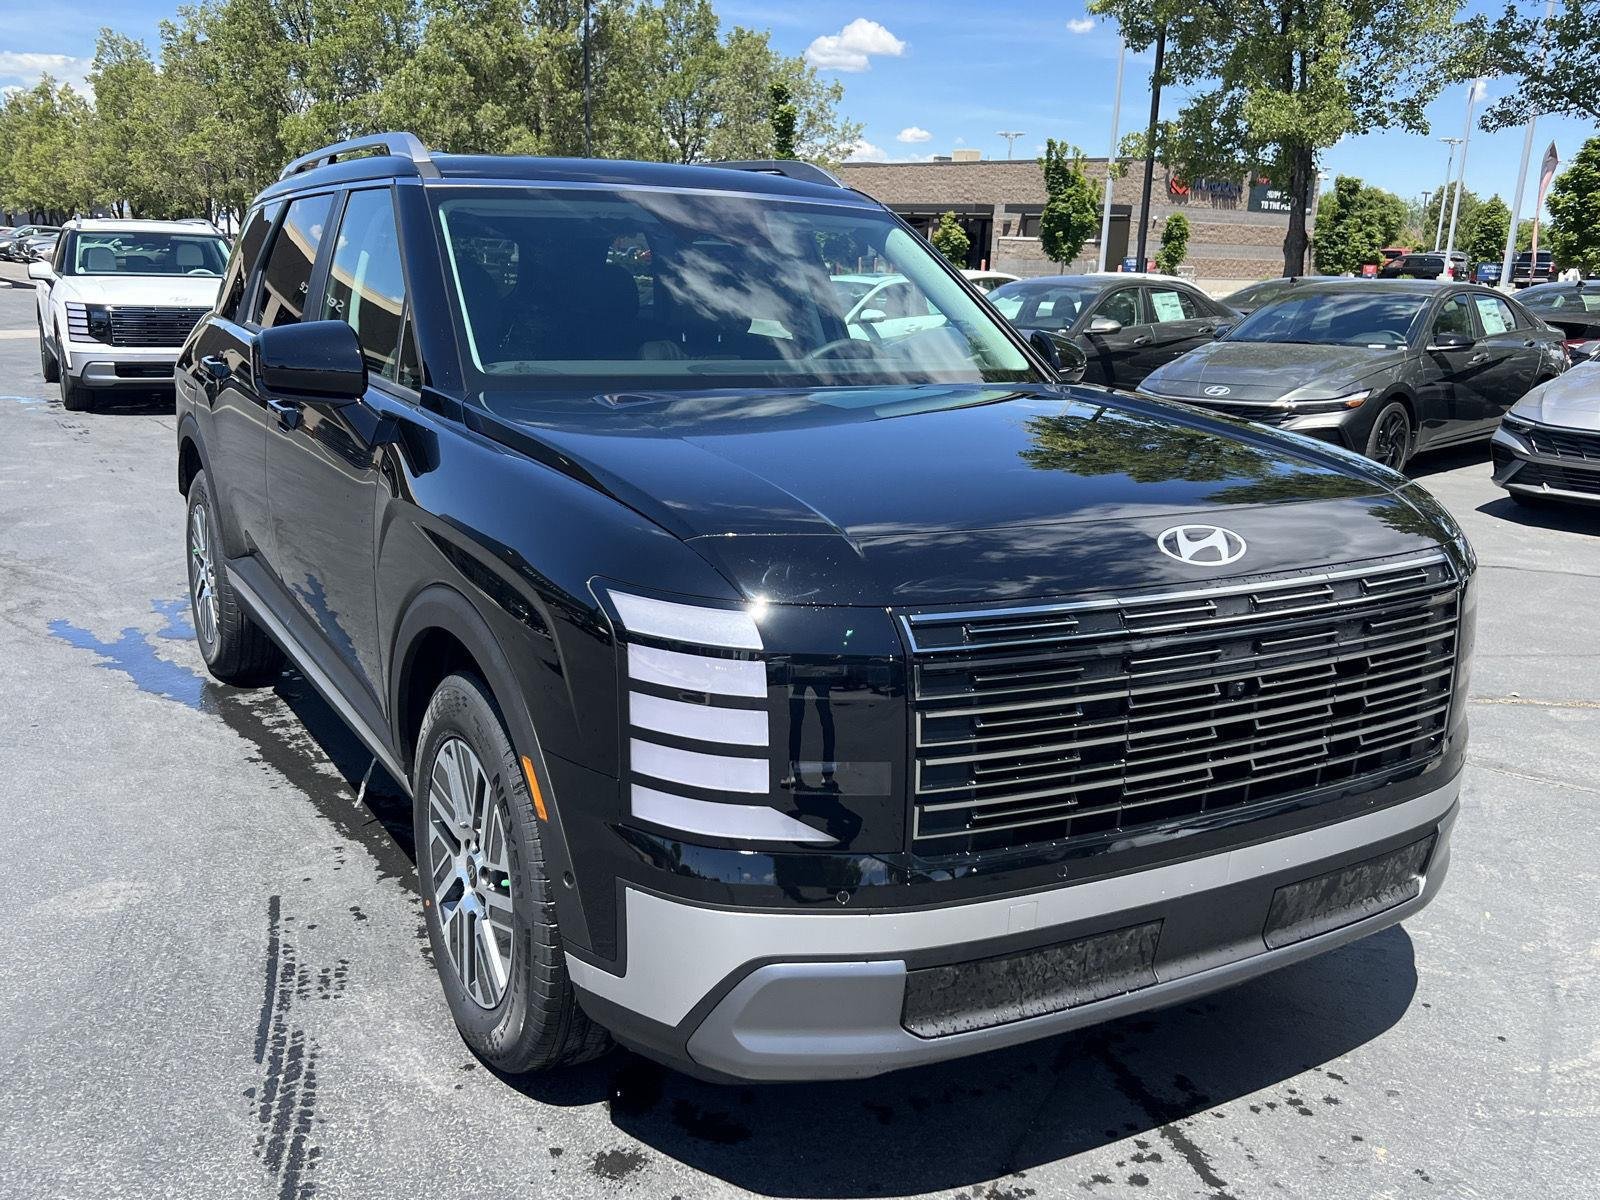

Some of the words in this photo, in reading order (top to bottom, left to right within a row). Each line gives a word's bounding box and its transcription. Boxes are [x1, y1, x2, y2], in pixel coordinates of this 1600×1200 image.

[1261, 200, 1268, 209] TO
[1269, 201, 1281, 210] THE
[492, 772, 524, 900] NEXEN
